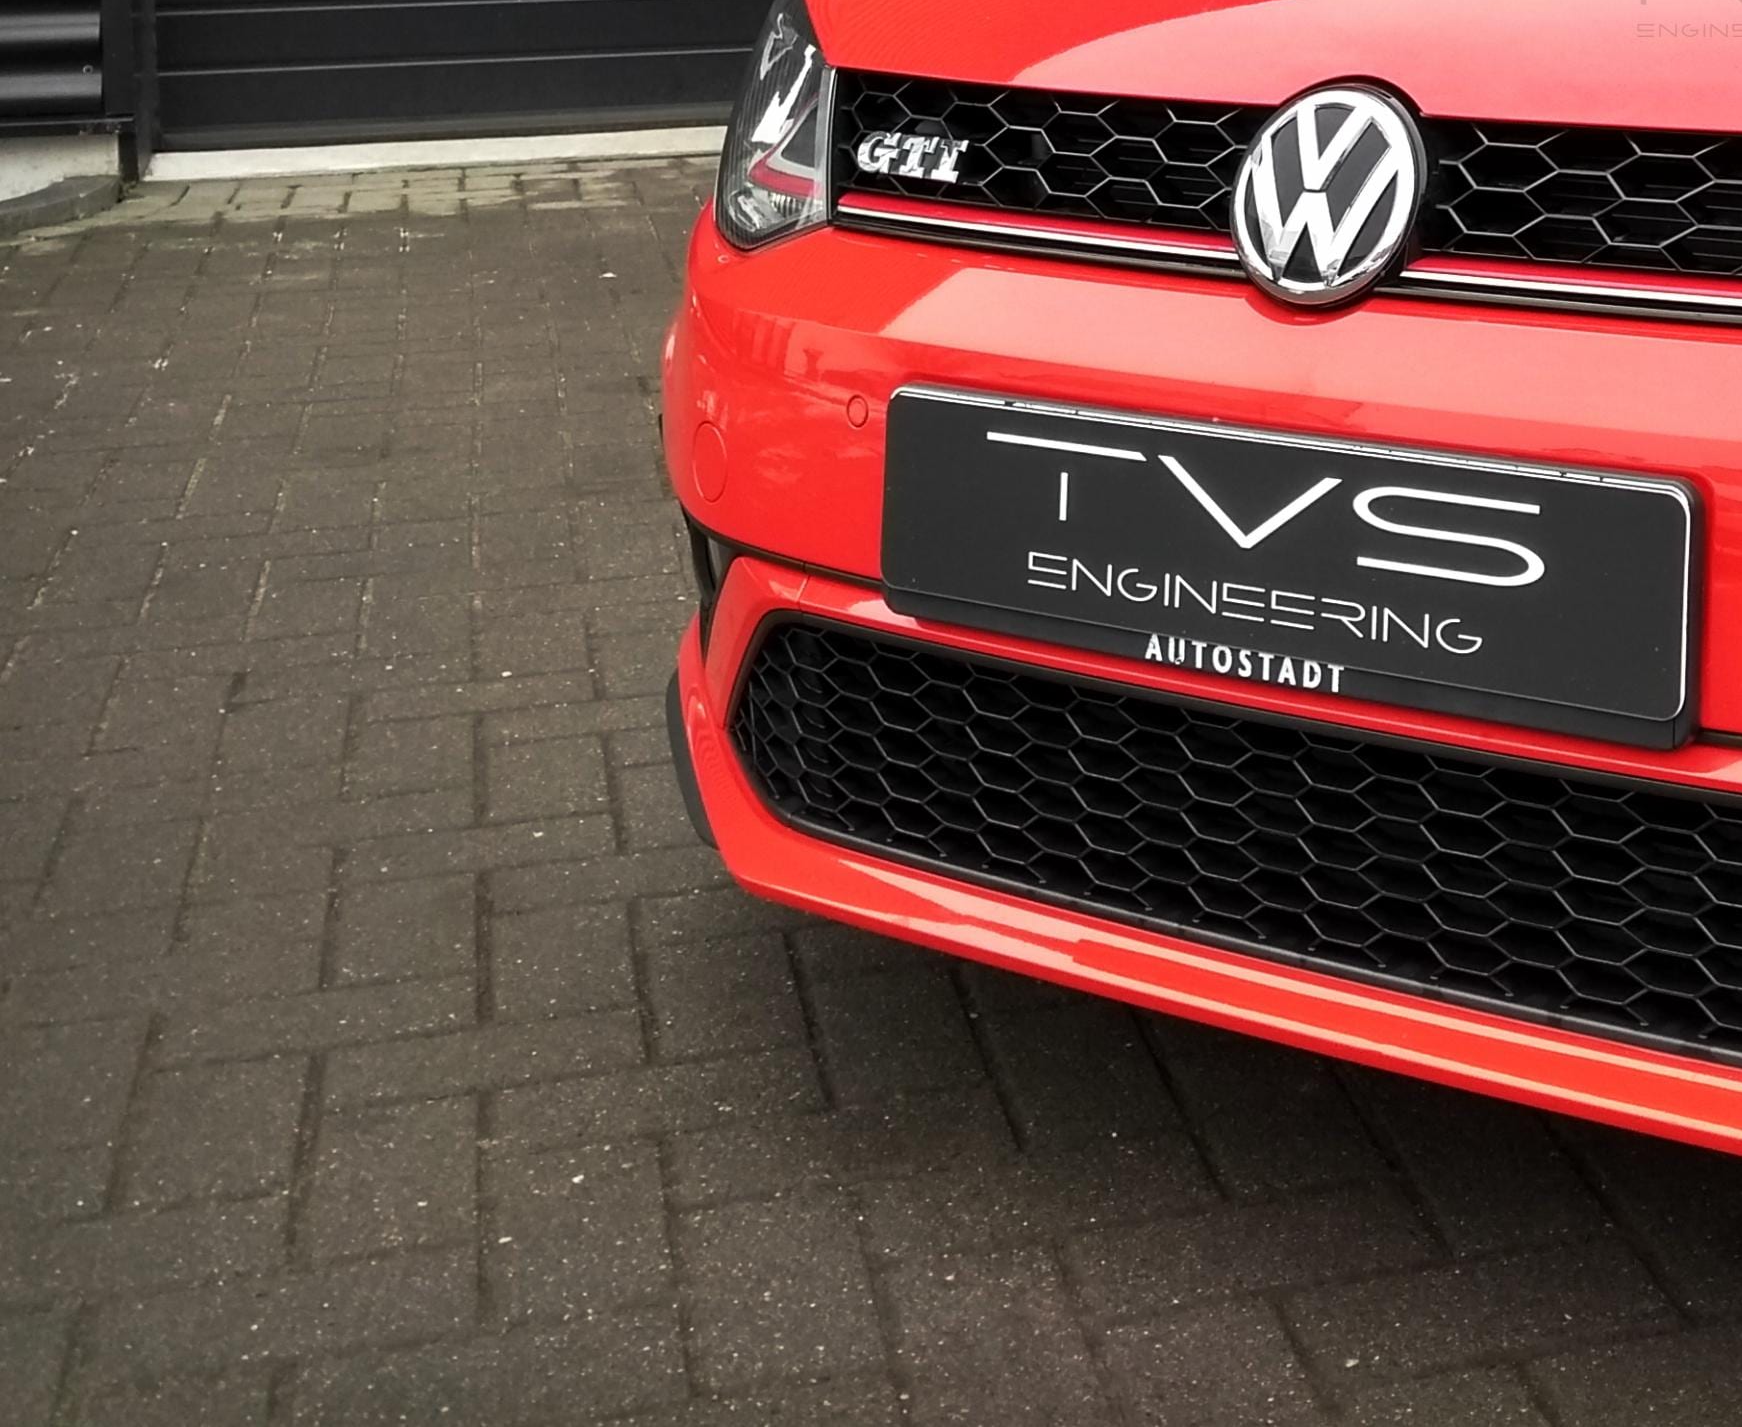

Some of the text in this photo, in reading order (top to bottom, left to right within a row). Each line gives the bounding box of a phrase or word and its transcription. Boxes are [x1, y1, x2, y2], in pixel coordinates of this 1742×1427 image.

[857, 131, 969, 184] GTI
[986, 431, 1545, 587] TVS
[1027, 551, 1483, 655] ENGINEERING
[1144, 633, 1345, 693] AUTOSTADT
